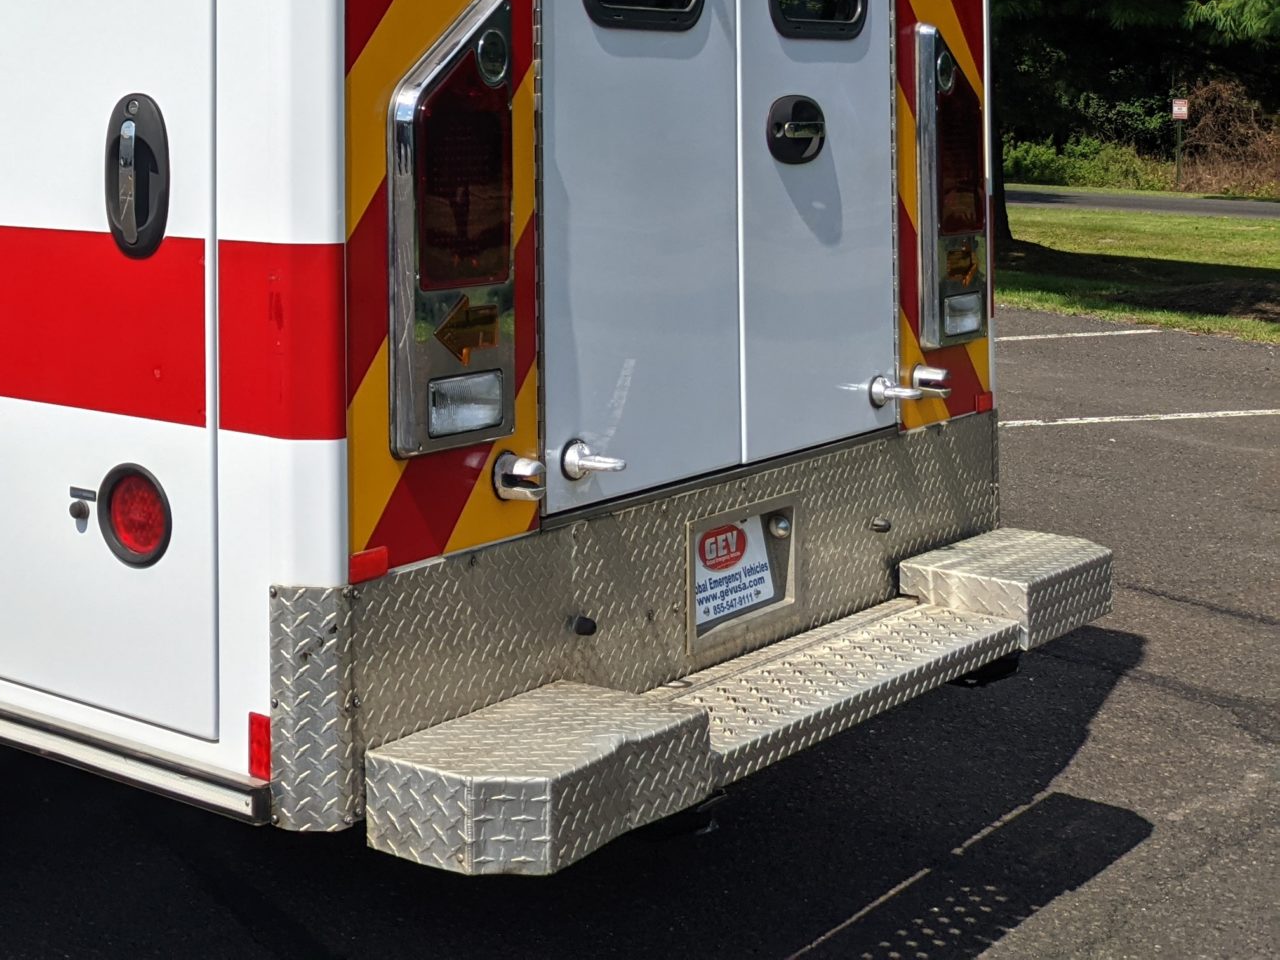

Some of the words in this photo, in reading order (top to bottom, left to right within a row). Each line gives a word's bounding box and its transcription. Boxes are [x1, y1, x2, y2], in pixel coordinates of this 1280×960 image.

[705, 530, 737, 560] GEV
[708, 571, 741, 590] Emergency
[742, 562, 768, 578] Vehicles
[696, 576, 765, 606] www.gevusa.com
[713, 592, 753, 615] 855-547-9111
